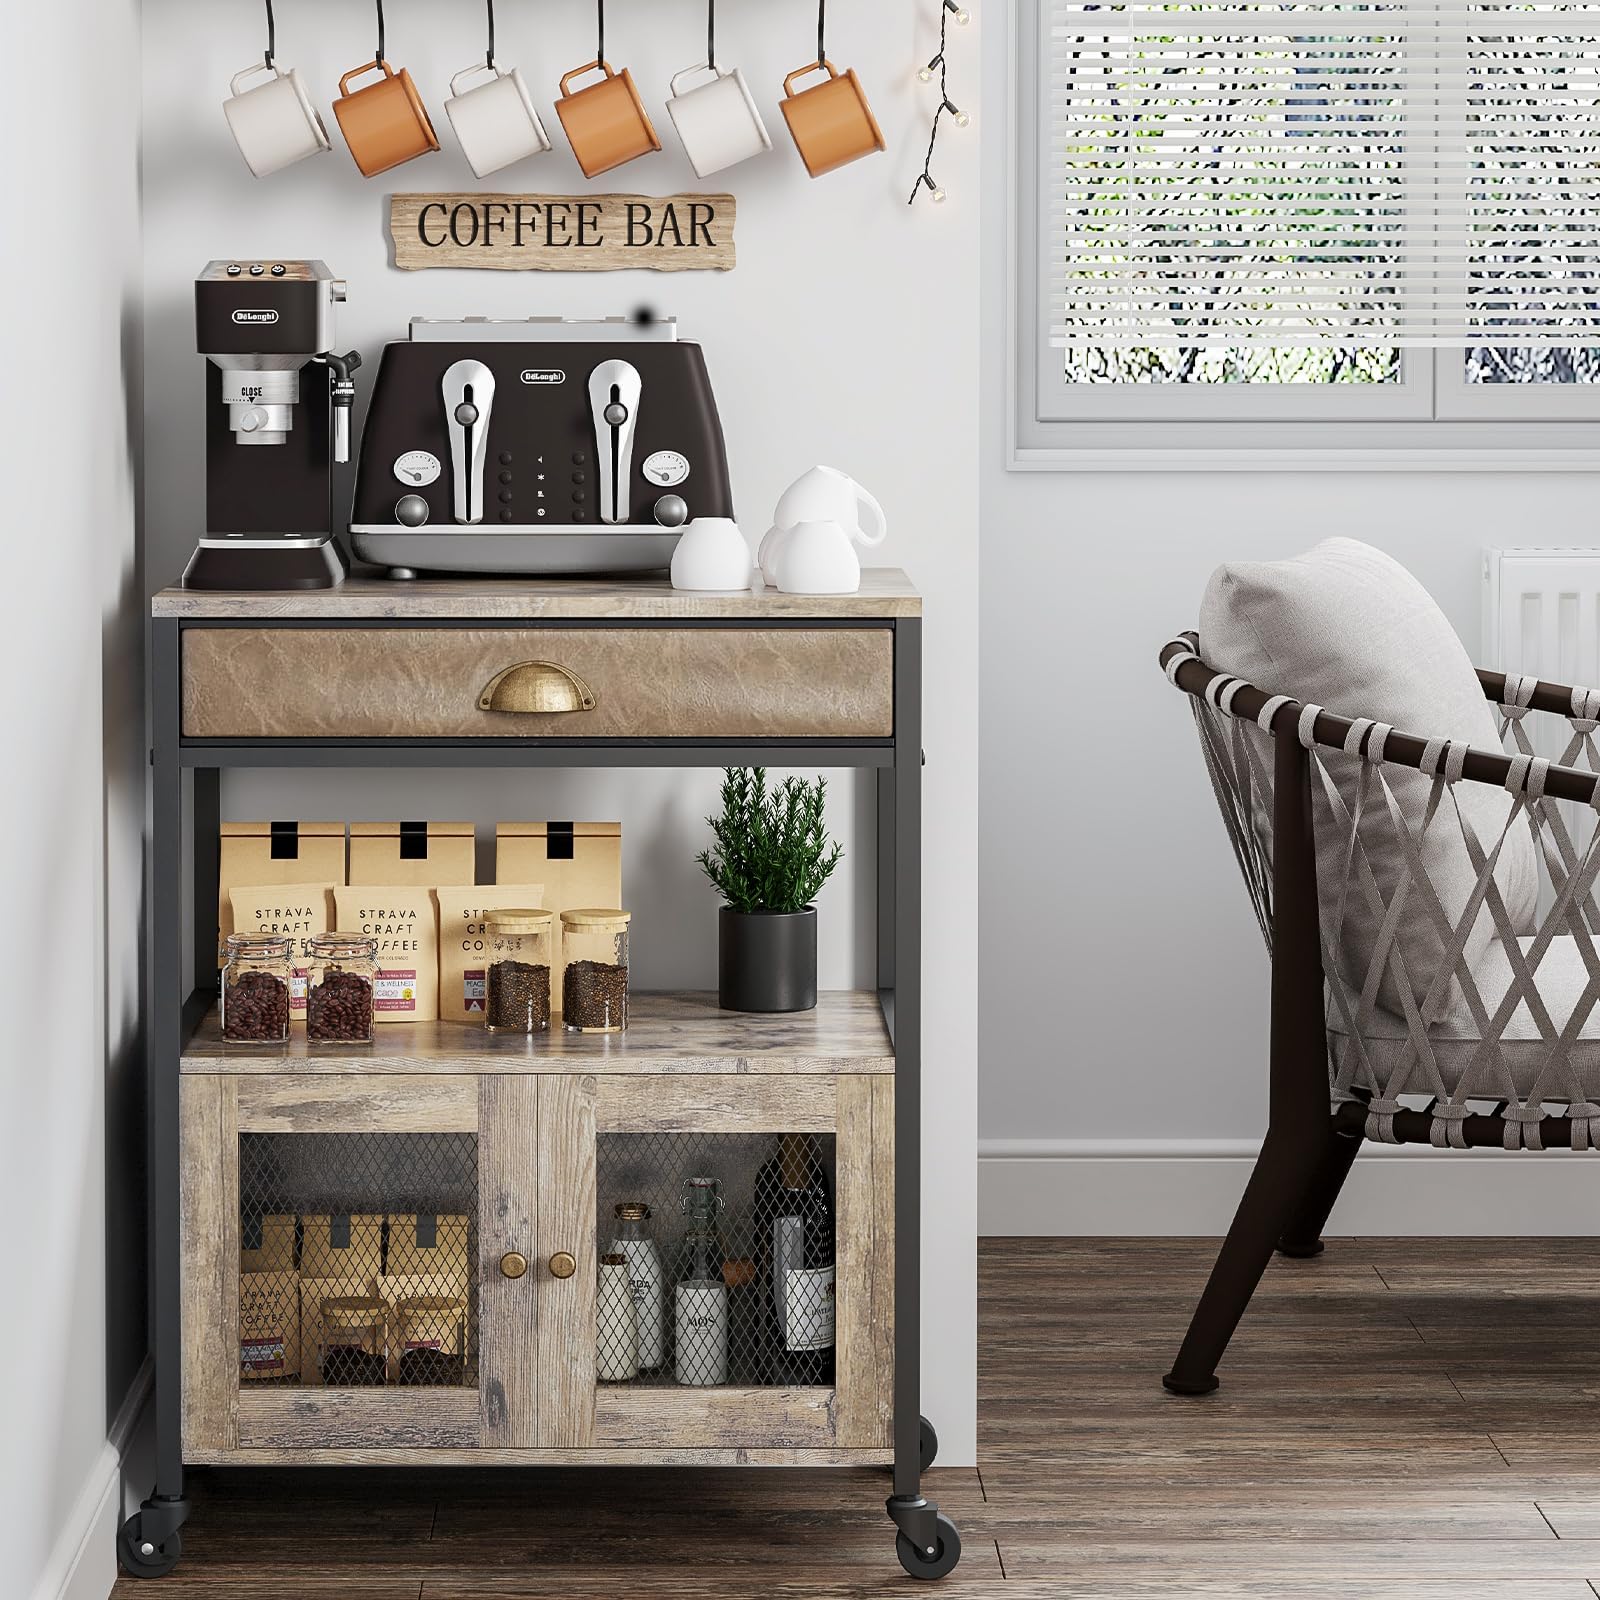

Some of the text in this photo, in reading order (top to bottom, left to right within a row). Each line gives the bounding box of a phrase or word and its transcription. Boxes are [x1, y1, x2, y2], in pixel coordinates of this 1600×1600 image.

[418, 203, 717, 247] COFFEE BAR
[241, 387, 262, 396] CLOSE
[259, 922, 310, 933] CRAFT
[362, 924, 413, 935] CRAFT
[370, 940, 418, 951] OFFEE
